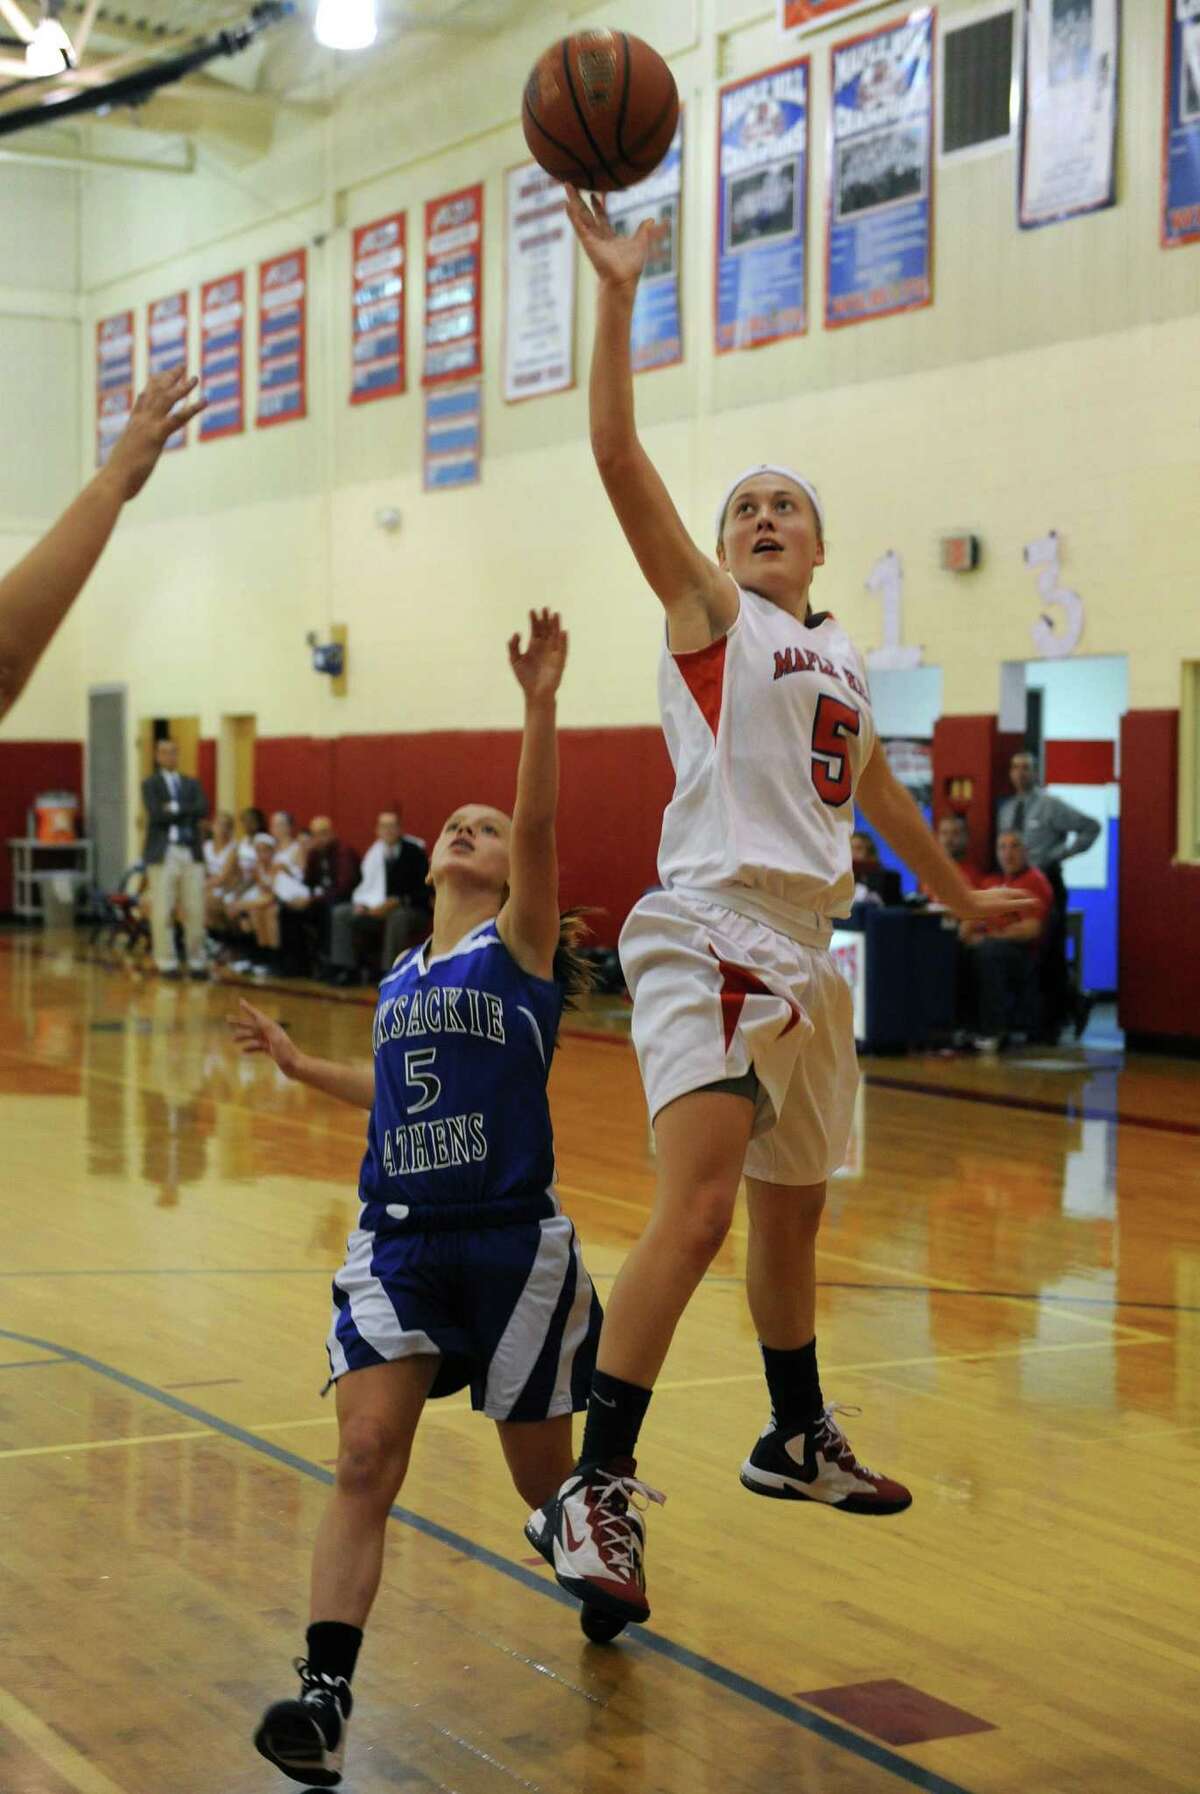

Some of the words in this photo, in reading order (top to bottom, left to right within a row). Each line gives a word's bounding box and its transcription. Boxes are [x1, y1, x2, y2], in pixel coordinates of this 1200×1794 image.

[864, 549, 925, 669] 1
[811, 692, 860, 808] 5
[404, 1047, 442, 1115] 5
[383, 1112, 488, 1177] ATHENS
